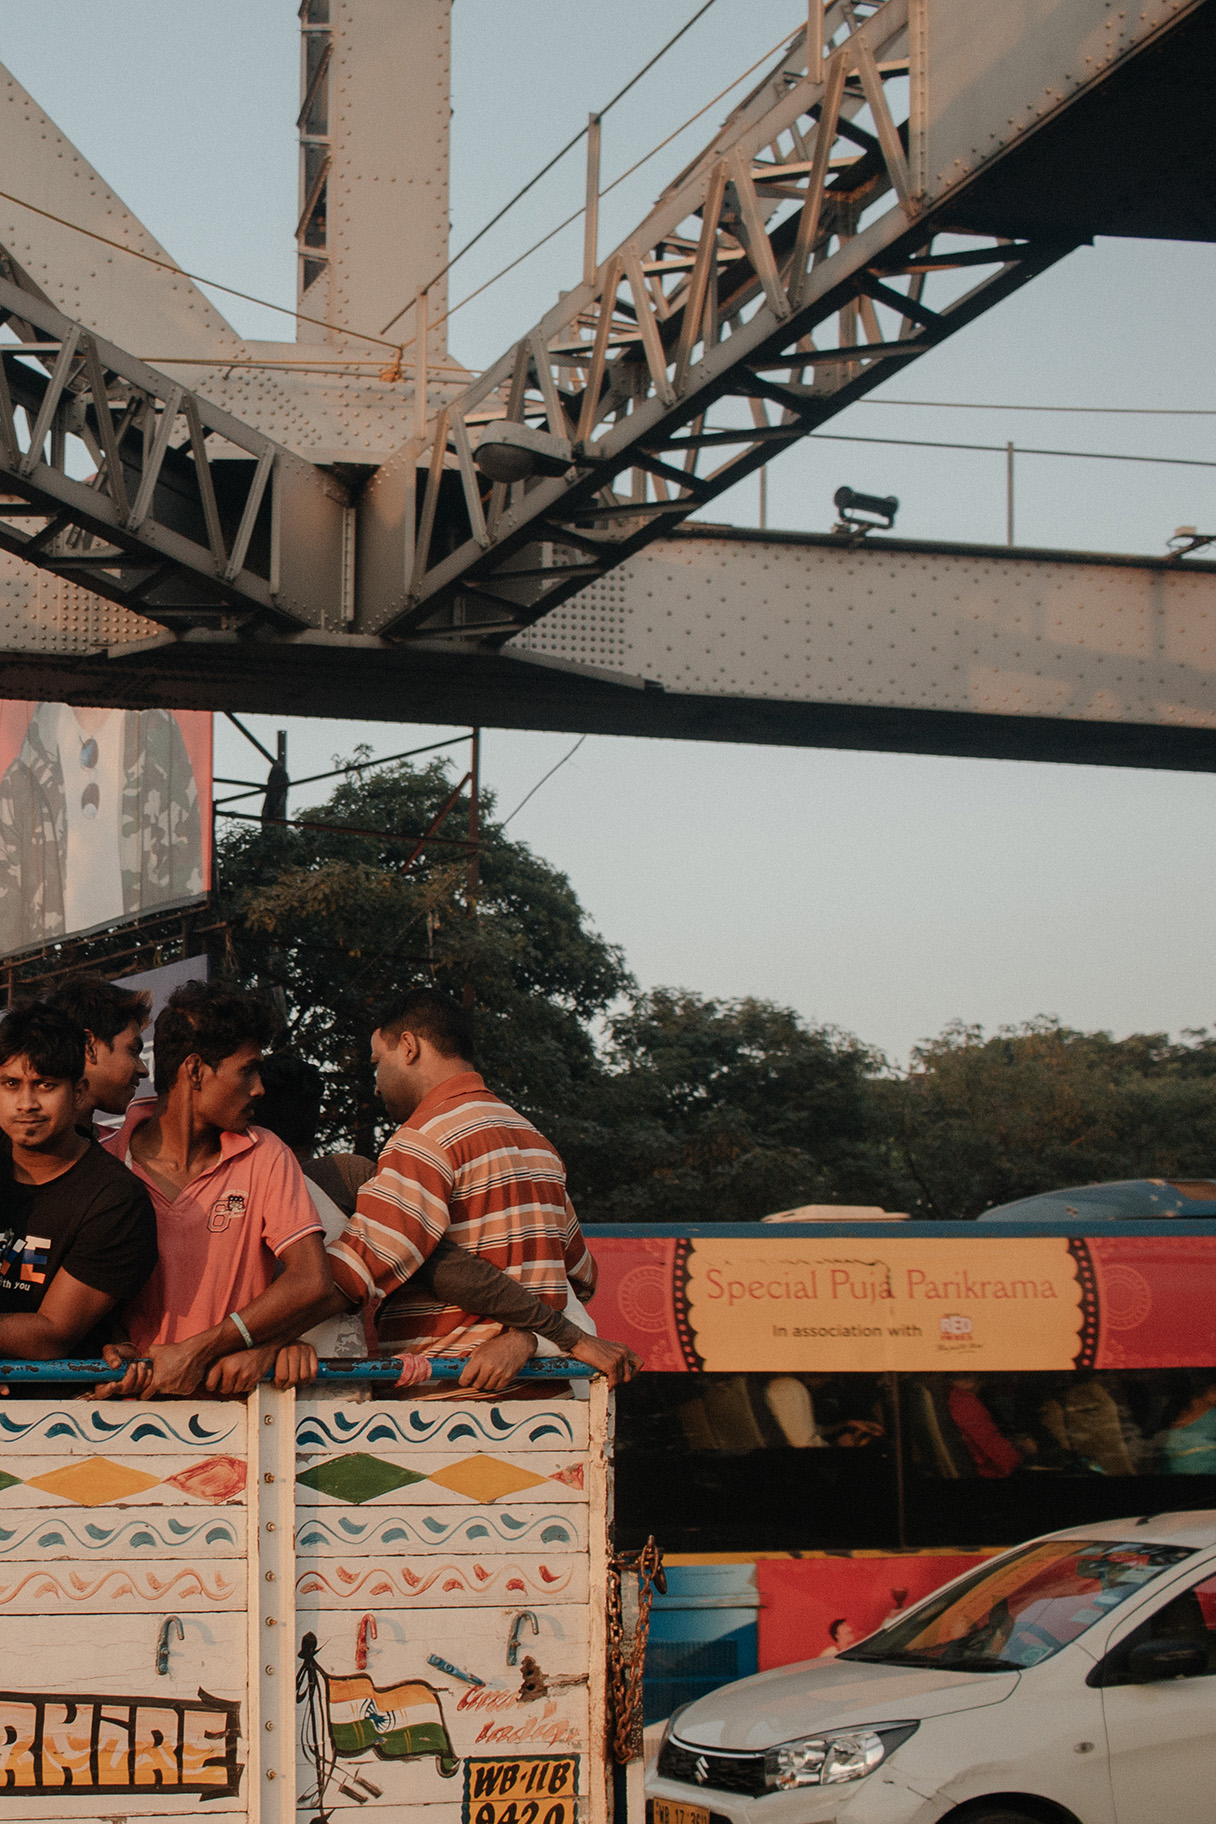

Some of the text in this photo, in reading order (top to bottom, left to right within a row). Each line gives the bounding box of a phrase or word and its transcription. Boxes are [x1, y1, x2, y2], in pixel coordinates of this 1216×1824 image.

[13, 1281, 31, 1292] you
[706, 1268, 1058, 1306] Special Puja Parikrama
[773, 1325, 788, 1338] In
[792, 1324, 883, 1339] association
[888, 1325, 923, 1338] with
